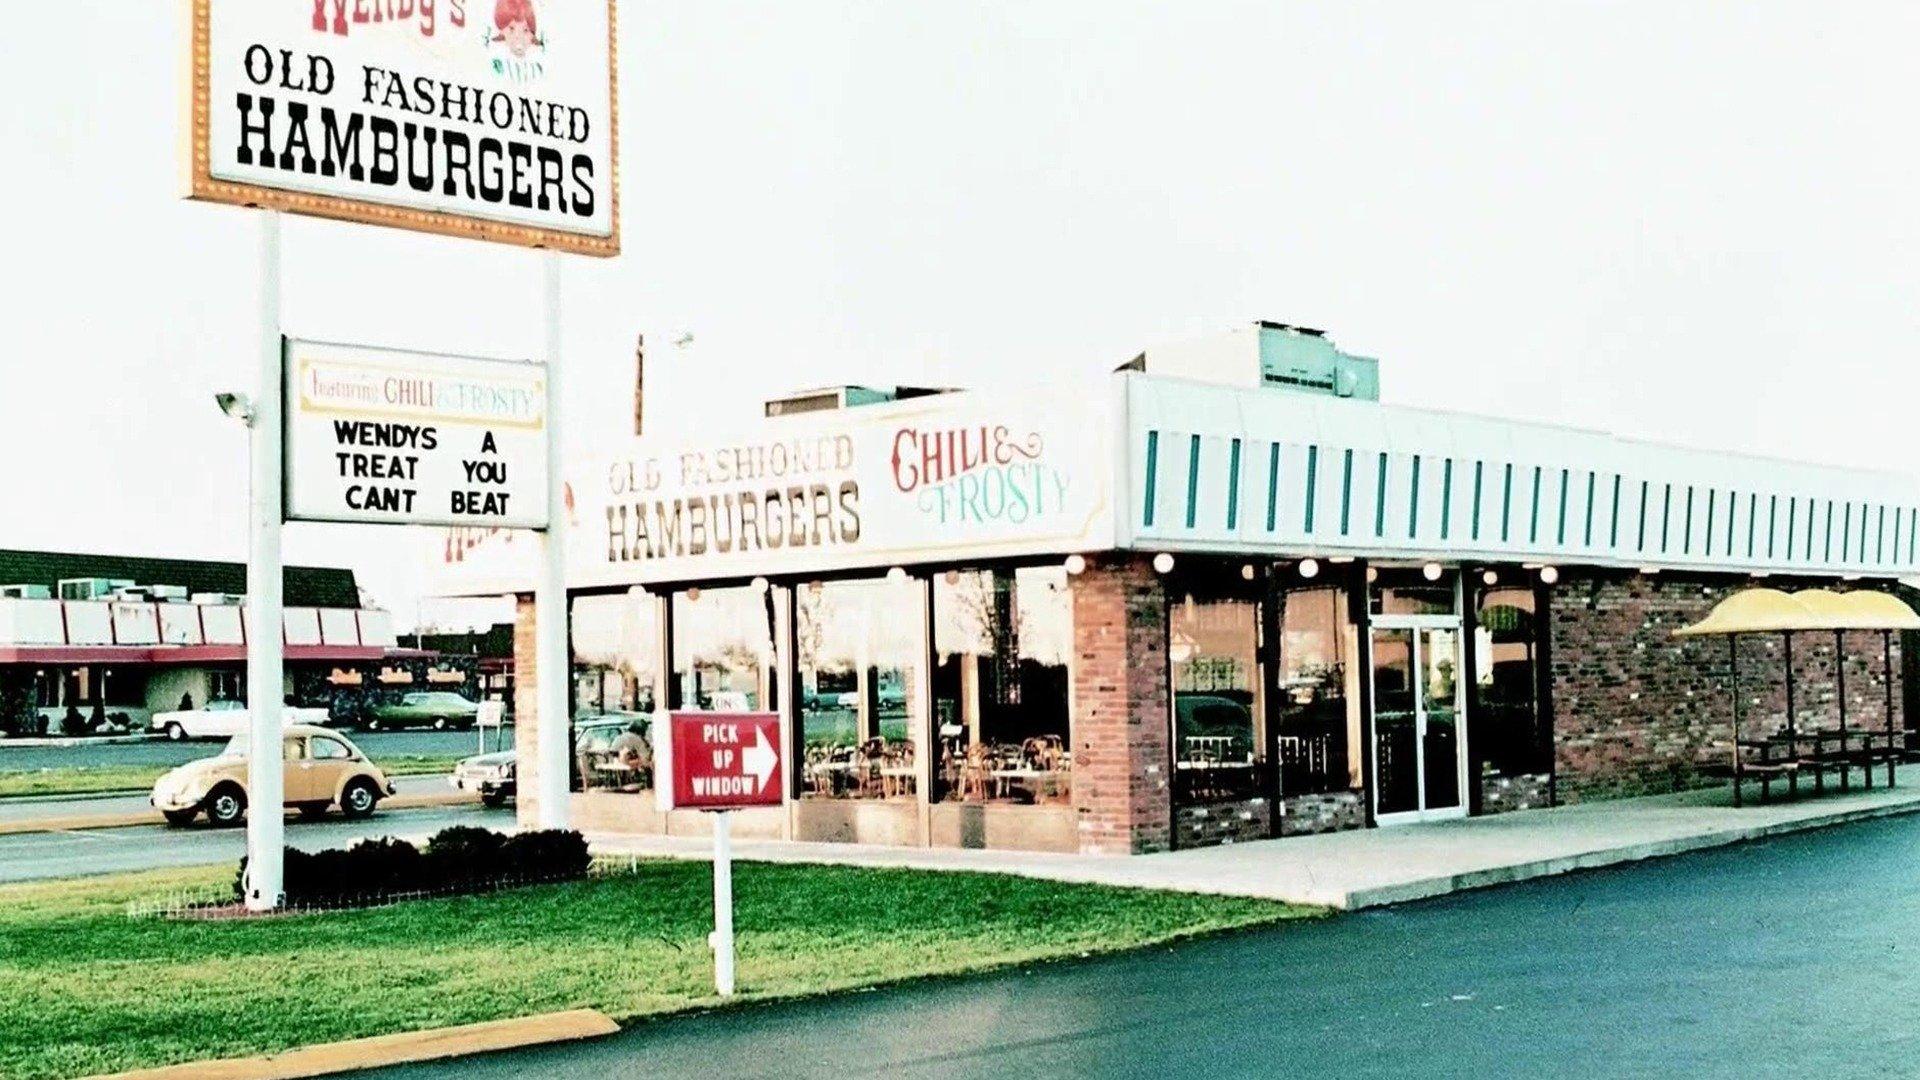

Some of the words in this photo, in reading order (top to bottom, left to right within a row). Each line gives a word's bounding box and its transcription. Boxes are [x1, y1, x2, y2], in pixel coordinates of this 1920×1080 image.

[244, 44, 334, 95] OLD
[362, 65, 590, 143] FASHIONED
[237, 93, 594, 217] HAMBURGERS
[383, 376, 434, 408] CHILI
[334, 420, 437, 450] WENDYS
[481, 431, 497, 454] A
[336, 452, 419, 480] TREAT
[462, 460, 506, 484] YOU
[609, 458, 661, 495] OLD
[680, 434, 855, 487] FASHIONED
[345, 485, 417, 513] CANT
[451, 491, 510, 515] BEAT
[918, 463, 1071, 524] FROSTY
[606, 480, 861, 562] HAMBURGERS
[703, 724, 738, 743] PICK
[713, 750, 734, 769] UP
[692, 777, 753, 796] WINDOW
